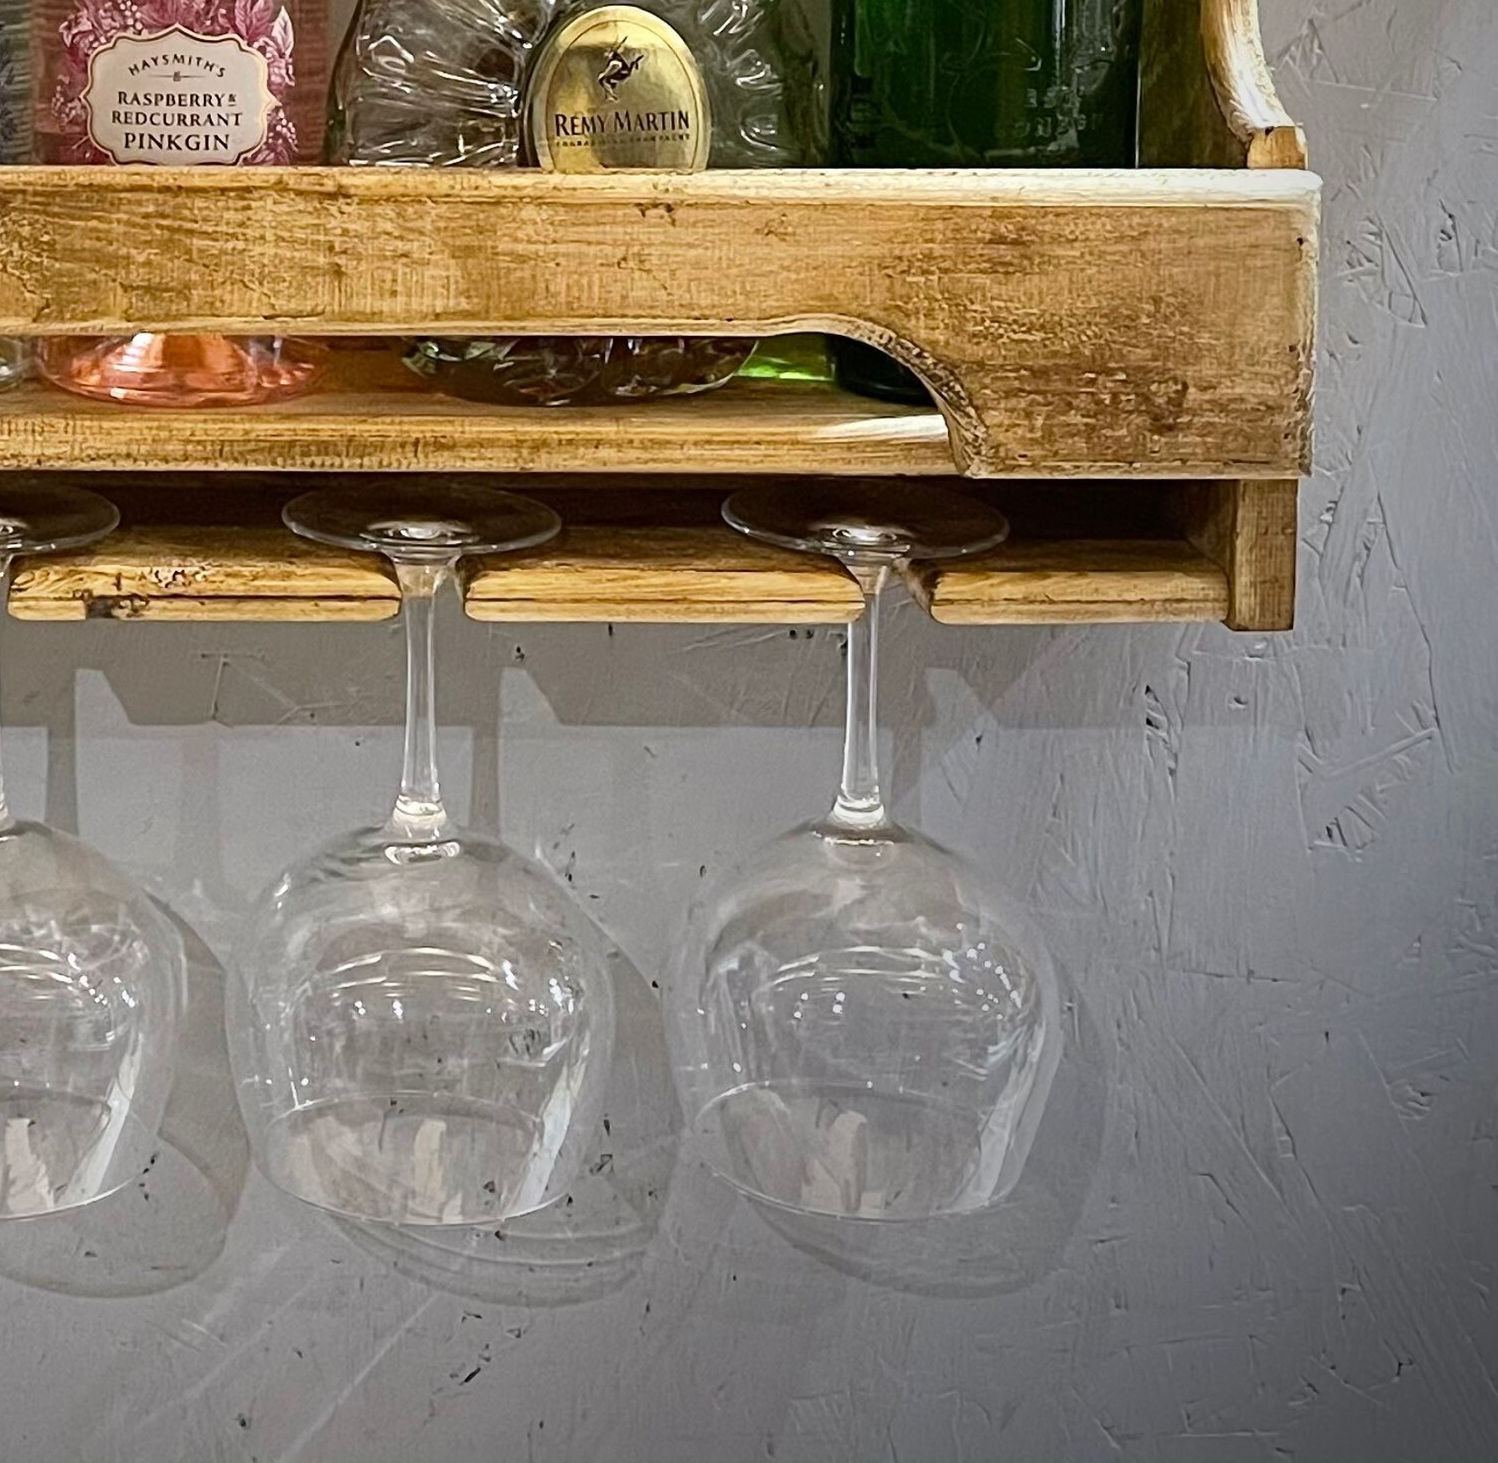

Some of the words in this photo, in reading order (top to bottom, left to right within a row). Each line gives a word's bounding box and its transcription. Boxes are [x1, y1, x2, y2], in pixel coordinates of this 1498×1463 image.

[128, 53, 226, 78] HAYSMITH'S
[117, 91, 224, 107] RASPBERRY
[111, 111, 243, 127] REDCURRANT
[614, 109, 689, 132] MARTIN
